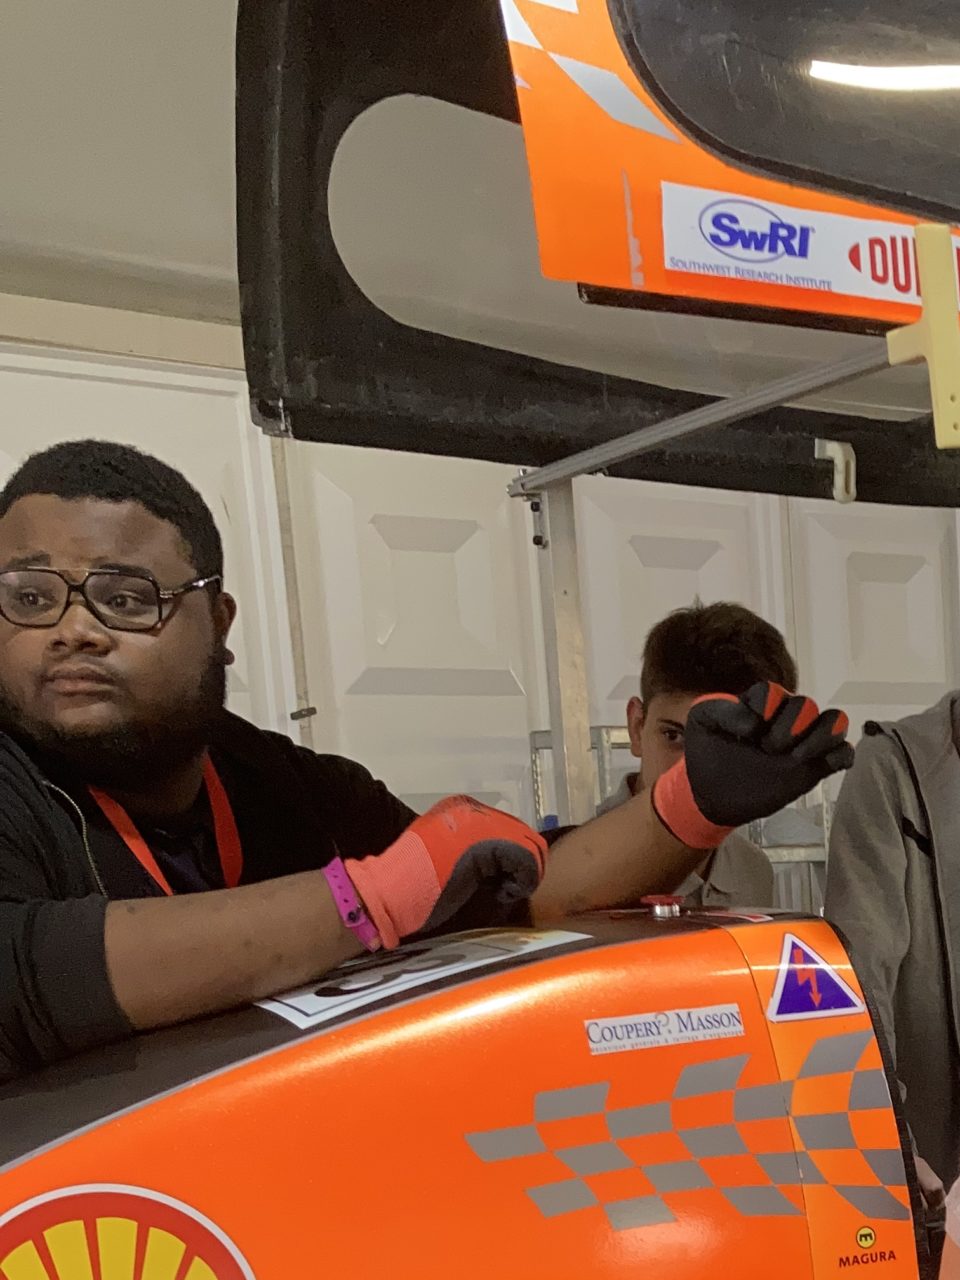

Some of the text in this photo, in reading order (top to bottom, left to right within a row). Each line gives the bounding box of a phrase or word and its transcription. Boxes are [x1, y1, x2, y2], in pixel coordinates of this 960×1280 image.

[707, 211, 811, 259] SwRI
[785, 272, 833, 291] INSTITUTE
[838, 1249, 896, 1268] MAGURA
